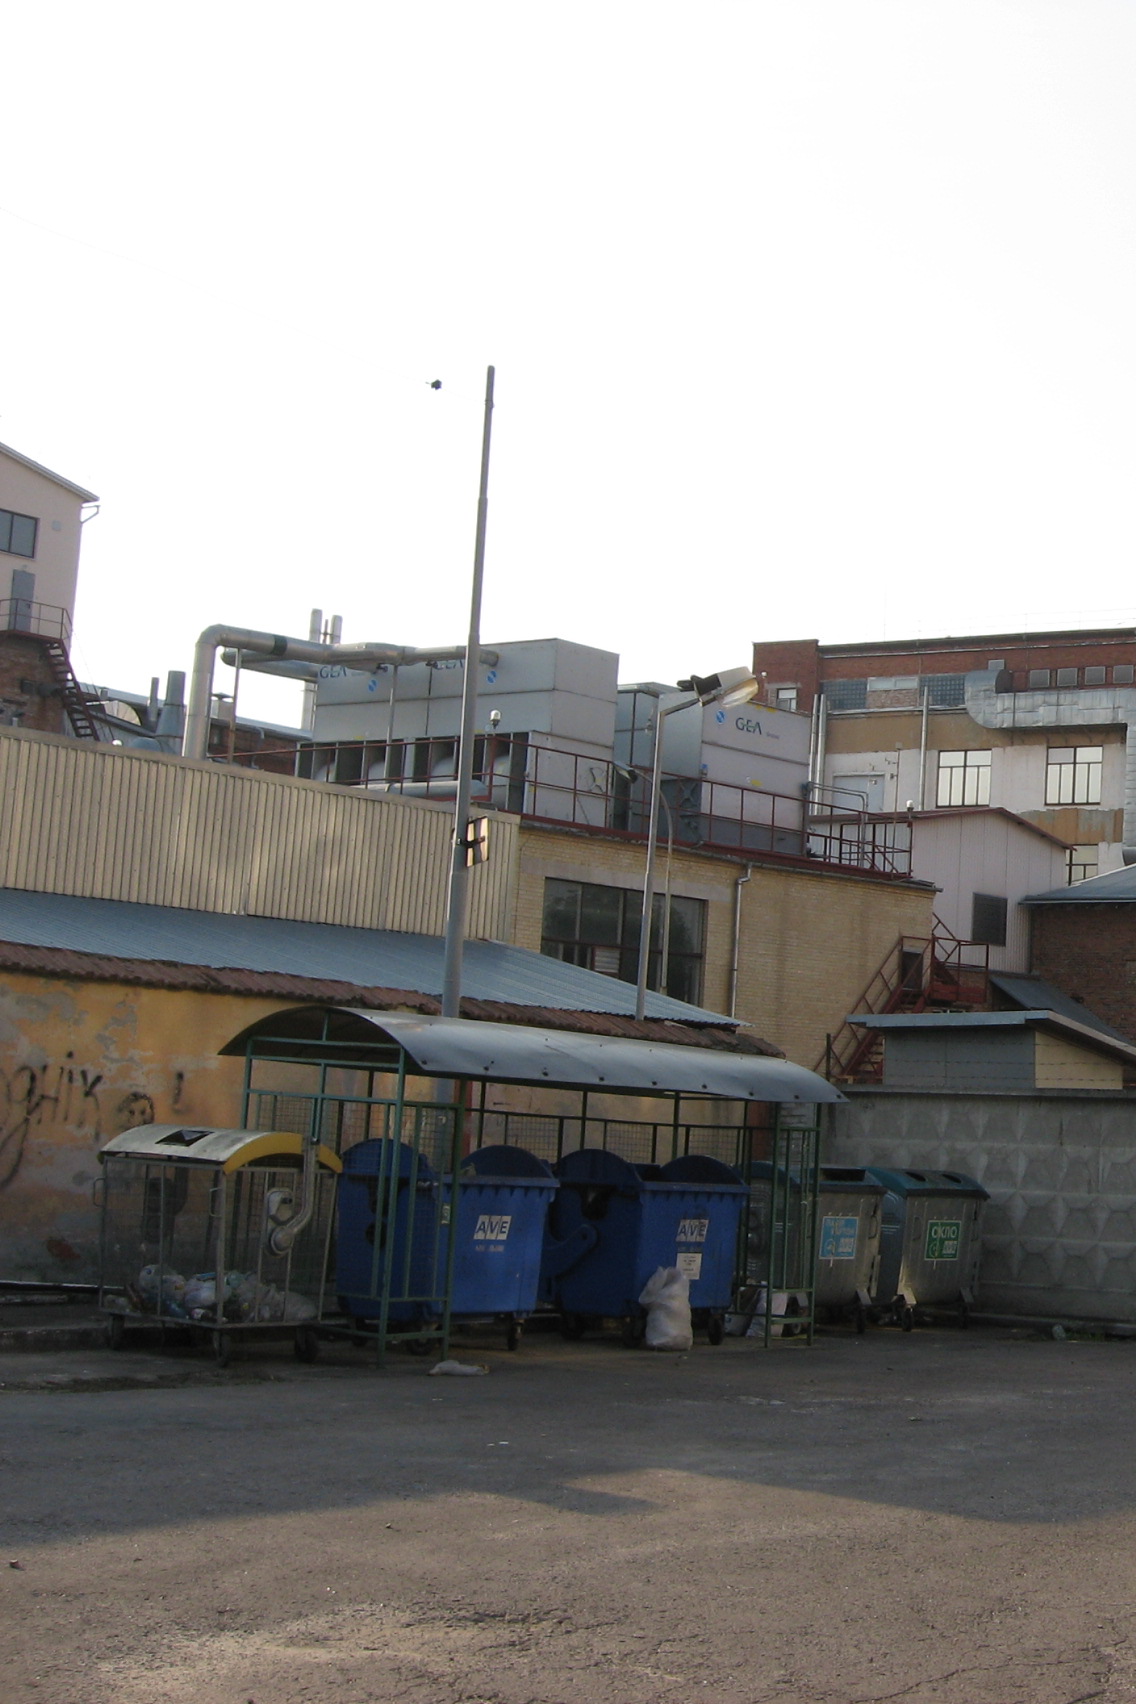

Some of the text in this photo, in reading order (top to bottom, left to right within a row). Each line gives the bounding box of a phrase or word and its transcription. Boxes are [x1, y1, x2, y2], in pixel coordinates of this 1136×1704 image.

[735, 717, 762, 735] GEA
[475, 1221, 509, 1234] AVE
[678, 1224, 707, 1237] AVE
